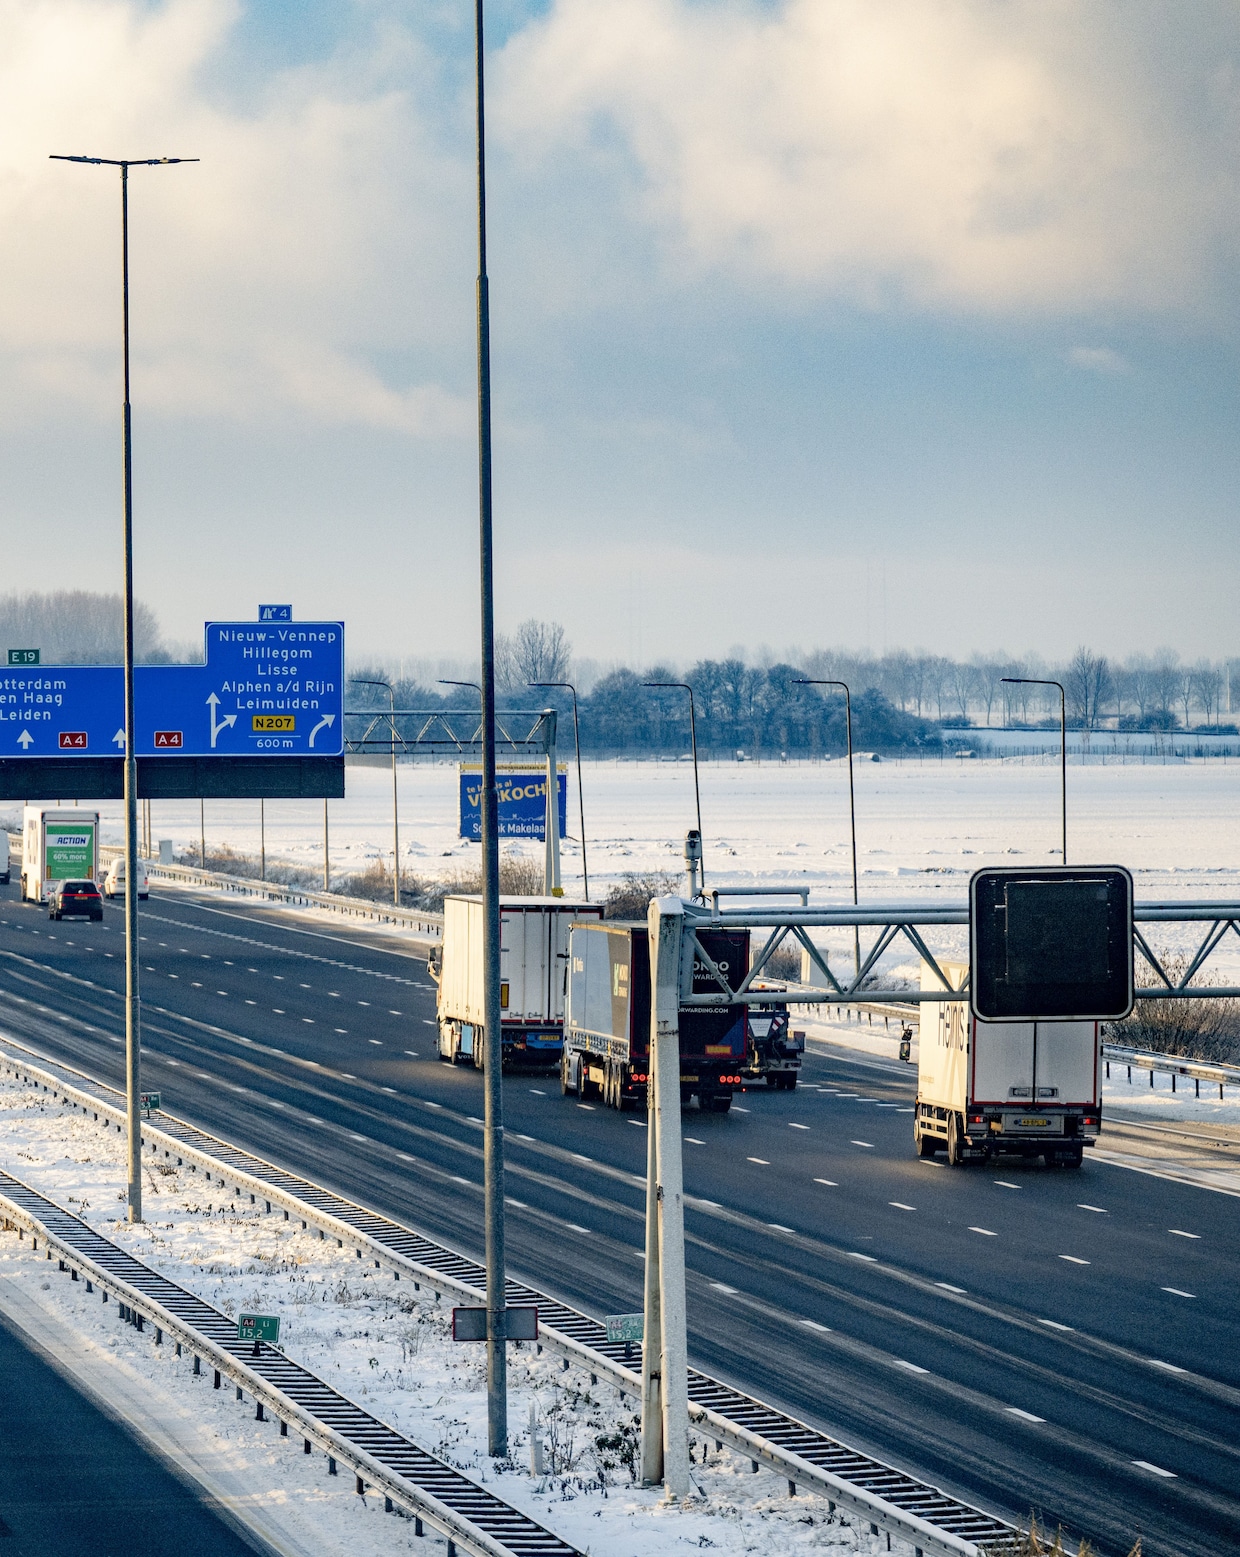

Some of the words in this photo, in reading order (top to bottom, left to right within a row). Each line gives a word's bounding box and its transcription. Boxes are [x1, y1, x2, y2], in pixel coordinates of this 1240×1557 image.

[279, 609, 288, 618] 4
[219, 630, 336, 643] Nieuw-Vennep
[11, 652, 20, 662] E
[23, 652, 36, 662] 19
[243, 647, 312, 661] Hillegom
[257, 664, 298, 675] Lisse
[221, 681, 271, 694] Alphen
[276, 680, 300, 692] a/d
[305, 680, 335, 695] Rijn
[24, 692, 63, 706] Haag
[236, 698, 319, 709] Leimuiden
[0, 709, 51, 720] Leiden
[255, 718, 292, 728] N207
[256, 739, 280, 748] 600
[282, 740, 293, 748] m
[507, 823, 545, 833] Makelaa
[57, 837, 87, 845] ACTION
[693, 961, 730, 972] ONDO
